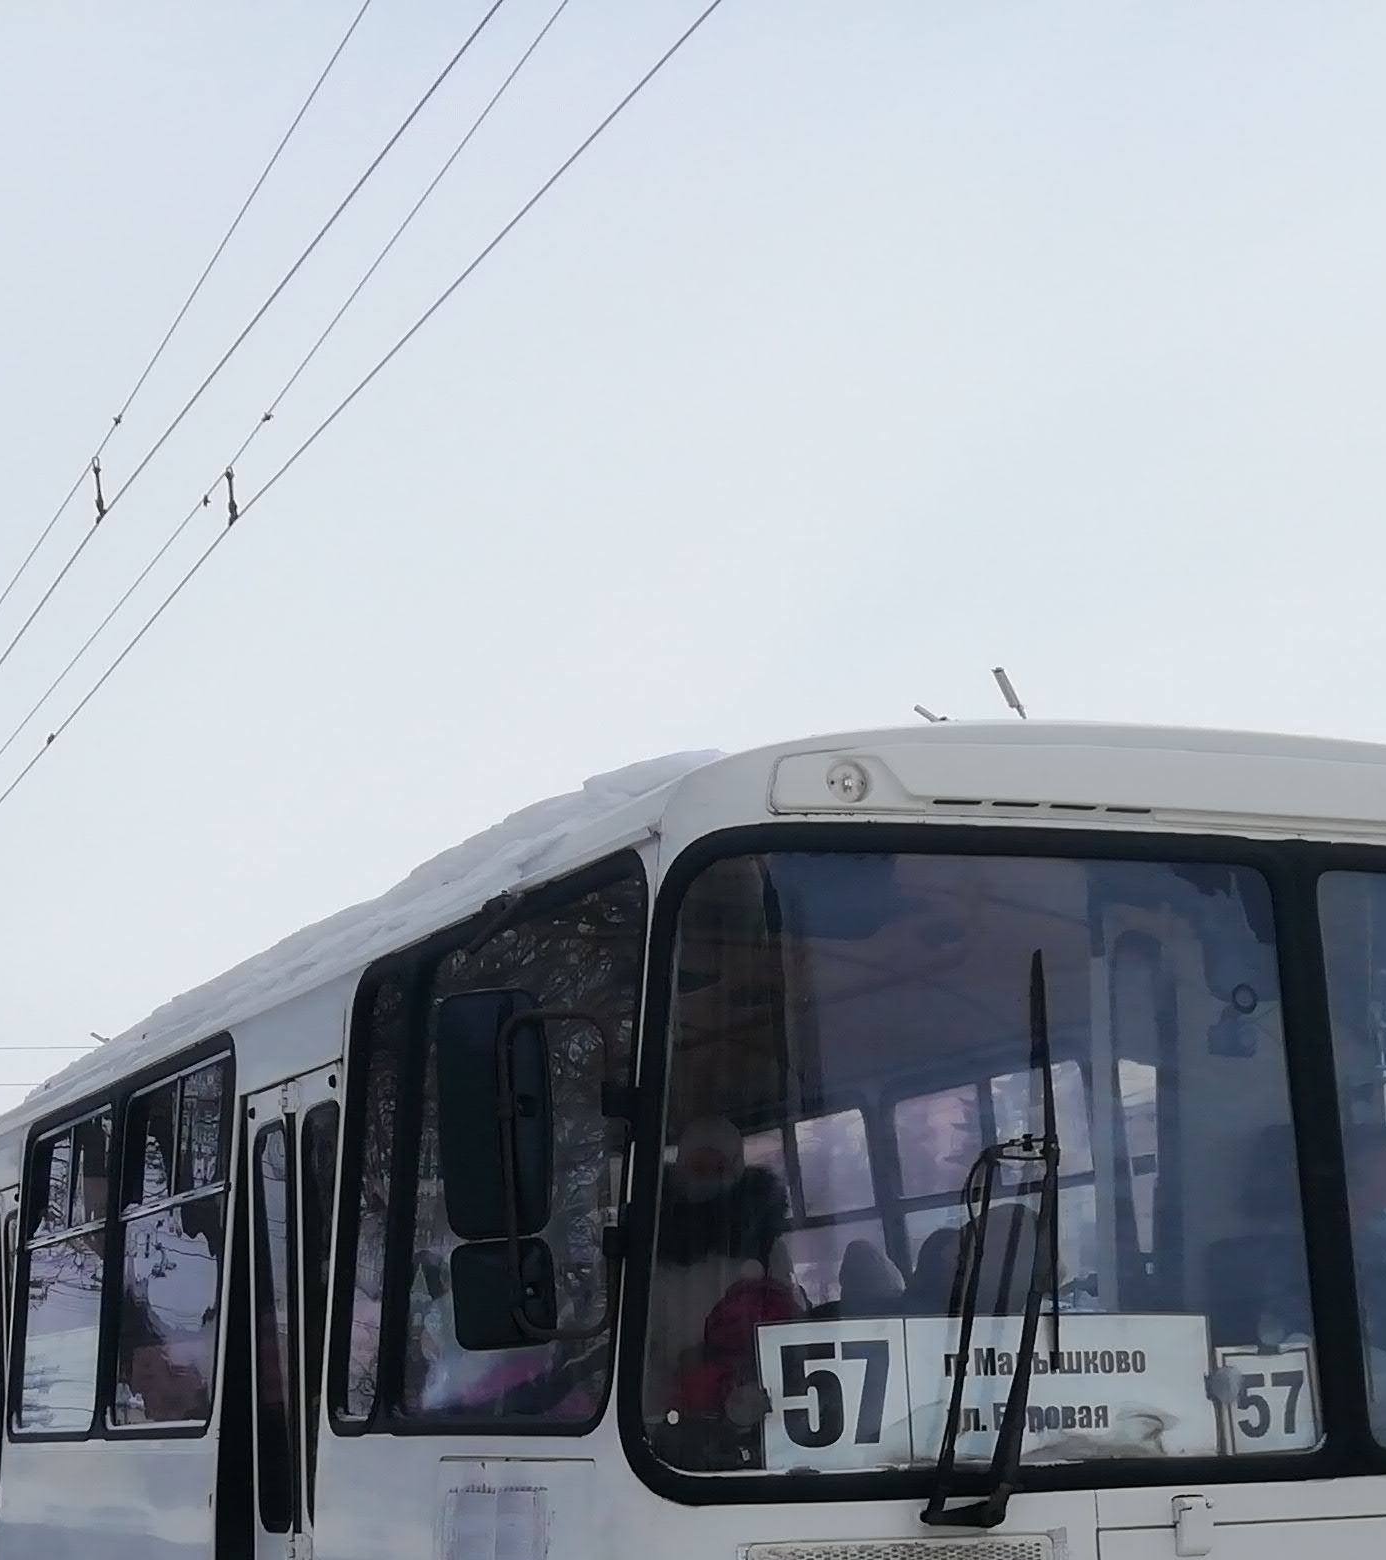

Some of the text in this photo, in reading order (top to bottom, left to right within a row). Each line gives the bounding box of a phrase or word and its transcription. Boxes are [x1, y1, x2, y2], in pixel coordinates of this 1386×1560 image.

[780, 1340, 890, 1448] 57
[974, 1347, 1146, 1377] Маышково
[1236, 1370, 1304, 1439] 57
